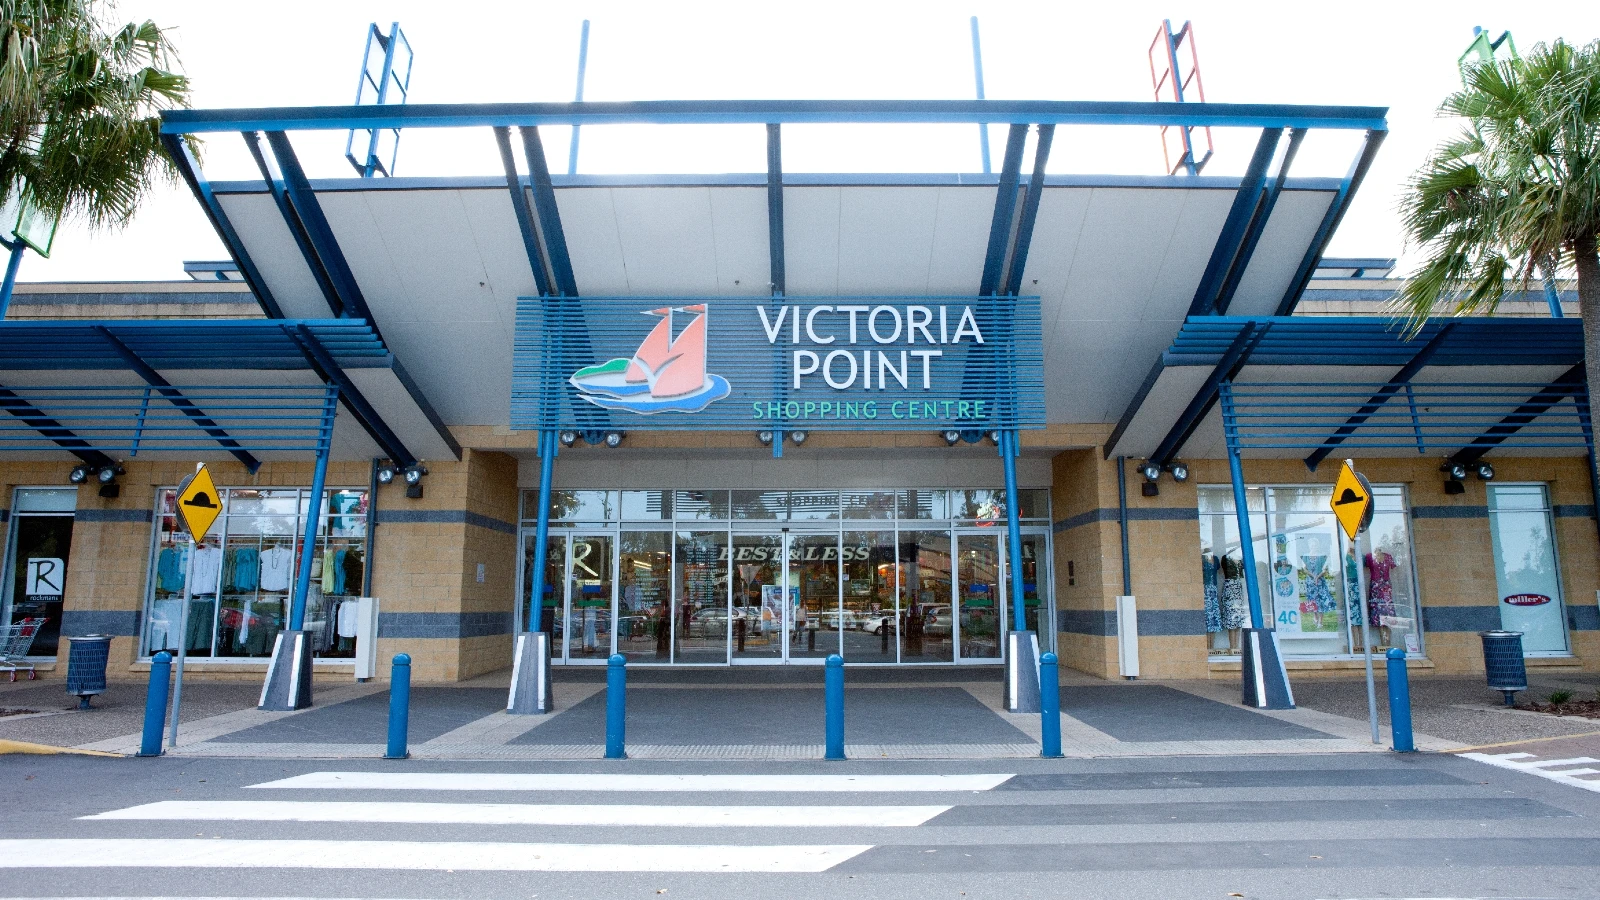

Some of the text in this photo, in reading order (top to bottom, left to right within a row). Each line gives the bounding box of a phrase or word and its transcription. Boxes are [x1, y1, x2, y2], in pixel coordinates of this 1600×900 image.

[756, 304, 985, 345] VICTORIA
[793, 349, 943, 390] POINT
[752, 400, 987, 420] SHOPPING CENTRE
[29, 560, 61, 593] R
